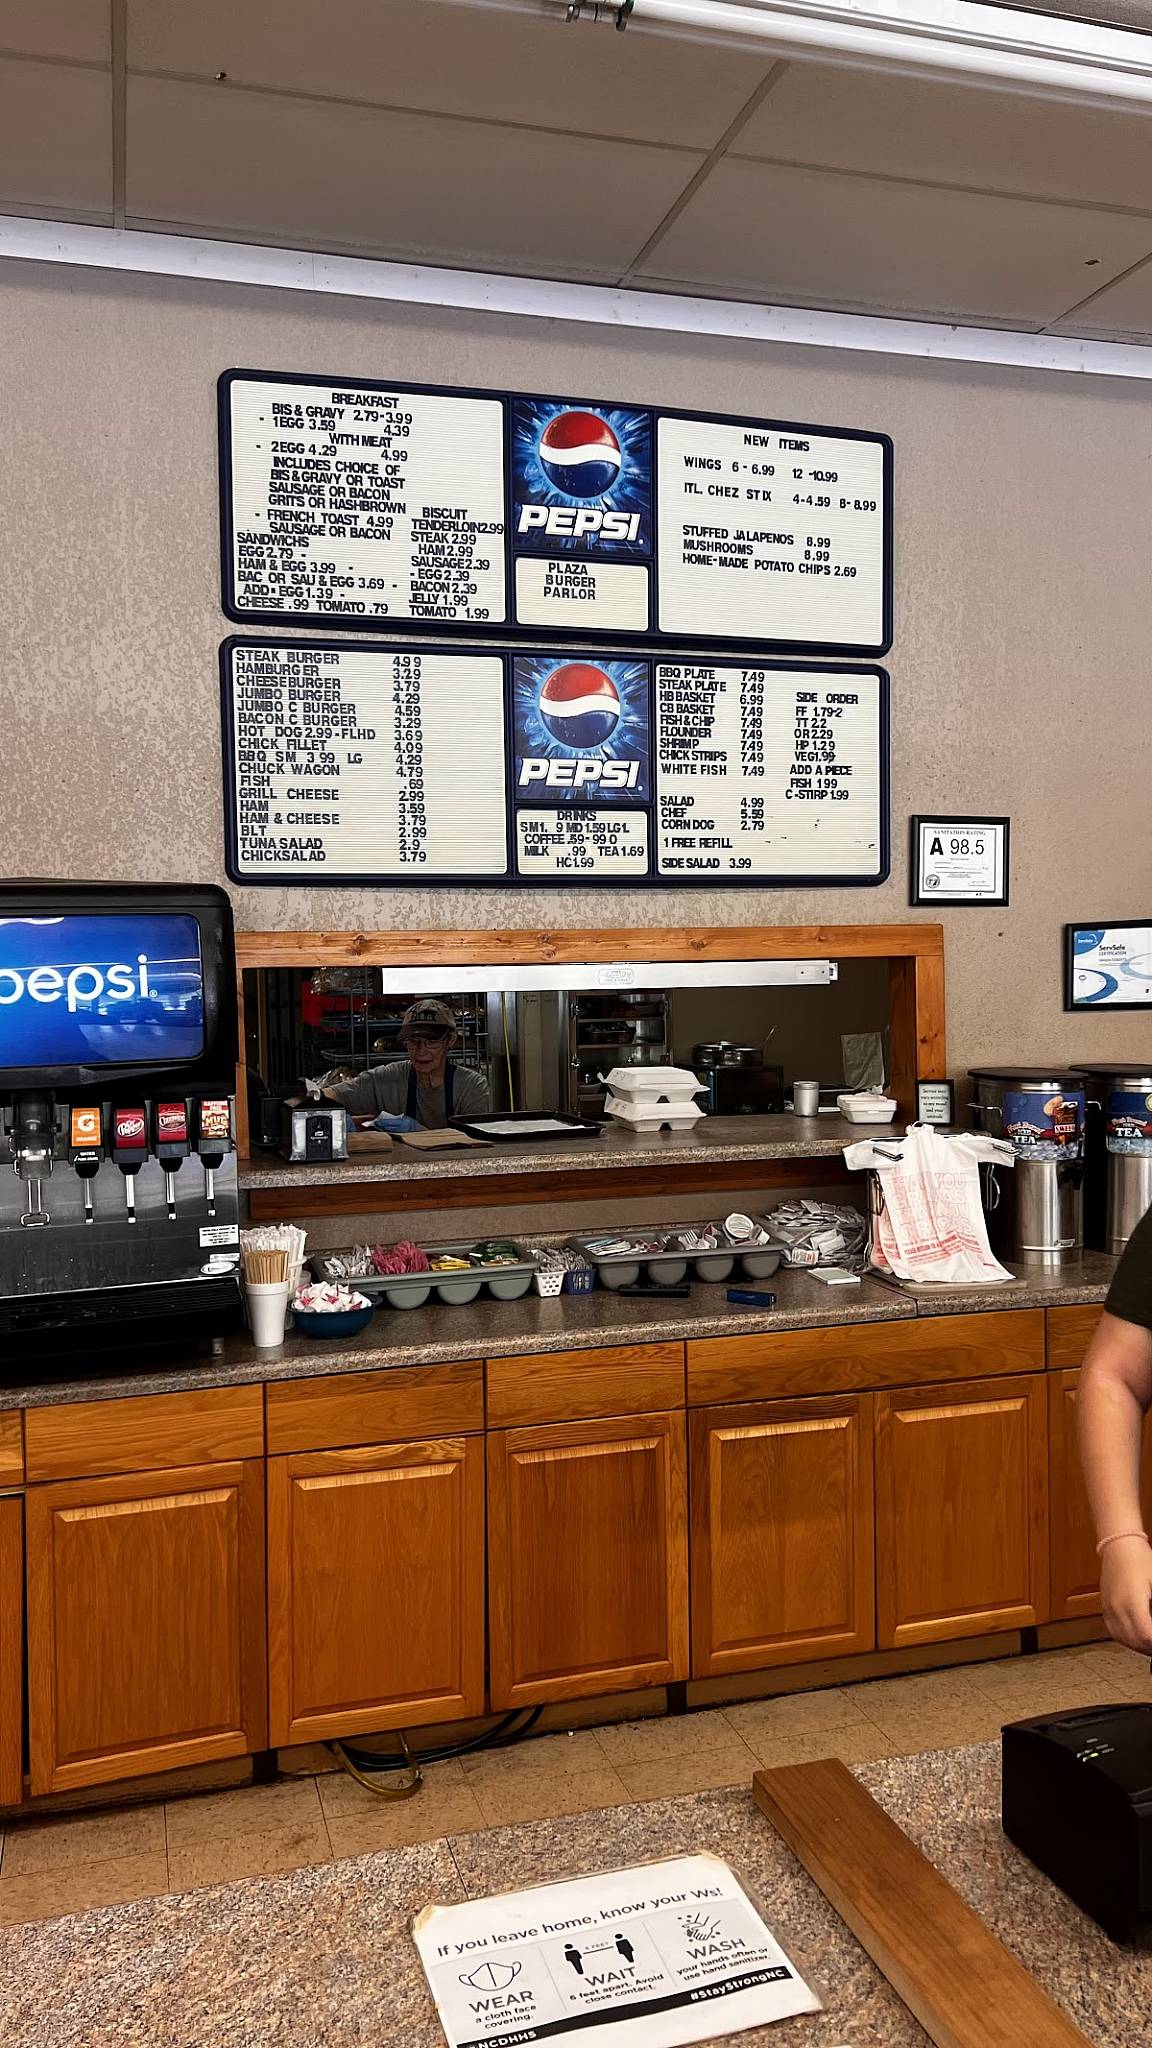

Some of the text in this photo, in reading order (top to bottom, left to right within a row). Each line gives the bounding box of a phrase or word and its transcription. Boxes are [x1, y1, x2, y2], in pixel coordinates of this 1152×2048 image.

[332, 393, 399, 408] BREAKFAST
[306, 406, 345, 419] GRAVY
[329, 433, 392, 448] WITH MEAT
[744, 434, 810, 451] NEW ITEMS
[273, 457, 379, 475] INCLUDES CHOICE
[684, 456, 803, 479] WINGS 6.99 12
[302, 470, 405, 489] GRAVY TOAST
[269, 482, 390, 500] SAUSAGE BACON
[684, 483, 739, 498] ITL. CHEZ
[268, 494, 406, 514] GRITS HASHBROWN
[267, 509, 359, 525] FRENCH TOAST
[422, 507, 468, 519] BISCUIT
[517, 504, 641, 541] PEPSI
[270, 522, 391, 540] SAUSAGE BACON
[411, 531, 450, 543] STEAK
[683, 525, 831, 548] STUFFED JALAPENOS 8.99
[237, 532, 309, 547] SANDWICHS
[684, 539, 830, 561] MUSHROOMS 8.99
[238, 558, 306, 572] HAM EGG
[549, 562, 588, 575] PLAZA
[683, 553, 856, 577] HOME-MADE POTATO CHIPS 2.69
[237, 571, 355, 587] BAC SAU EGG
[418, 569, 443, 579] EGG
[410, 580, 450, 592] BACON
[546, 574, 596, 588] BURGER
[409, 593, 439, 605] JELLY
[544, 586, 595, 600] PARLOR
[237, 595, 365, 613] CHEESE TOMATO
[410, 605, 457, 617] TOMATO
[236, 650, 340, 665] STEAK BURGER
[236, 662, 319, 676] HAMBURGER
[659, 667, 715, 679] BBQ PLATE
[236, 675, 341, 689] CHEESEBURGER
[659, 679, 726, 691] STEAK PLATE
[237, 688, 340, 701] JUMBO BURGER
[676, 692, 715, 703] BASKET
[796, 692, 858, 704] SIDE ORDER
[237, 701, 356, 714] JUMBO BURGER
[677, 704, 715, 715] BASKET
[237, 713, 357, 727] BACON BURGER
[660, 715, 715, 726] FISH CHIP
[238, 725, 302, 737] HOT DOG
[660, 726, 711, 738] FLOUNDER
[238, 738, 327, 751] CHICK FILLET
[660, 738, 699, 749] SHRIMP
[238, 751, 266, 761] BBQ
[660, 751, 727, 761] CHICK STRIPS
[238, 763, 340, 775] CHUCK WAGON
[518, 758, 640, 788] PEPSI
[661, 764, 727, 775] WHITE FISH
[790, 765, 852, 775] ADD PIECE
[241, 775, 270, 786] FISH
[238, 788, 339, 800] GRILL CHEESE
[240, 800, 269, 811] HAM
[660, 796, 694, 806] SALAD
[239, 813, 340, 825] HAM CHEESE
[557, 811, 596, 821] DRINKS
[661, 808, 687, 818] CHEF
[241, 825, 267, 836] BLT
[661, 819, 715, 830] CORN DOG
[671, 838, 733, 848] FREE REFILL
[930, 837, 984, 855] A 98.5
[524, 846, 619, 856] MILK TEA
[662, 858, 720, 868] SIDE SALAD
[206, 1115, 228, 1125] MUG
[1116, 1128, 1142, 1137] TEA
[1012, 1136, 1036, 1144] TEA
[437, 1887, 723, 1957] If you leave home, know your Ws!
[686, 1939, 746, 1960] WASH
[676, 1964, 699, 1975] your
[701, 1956, 730, 1968] hands
[731, 1950, 758, 1961] often
[584, 1967, 636, 1987] WAIT
[683, 1973, 700, 1981] use
[702, 1963, 727, 1976] hand
[579, 1990, 601, 1999] feet
[602, 1982, 633, 1995] apart.
[635, 1974, 664, 1986] Avoid
[691, 1969, 785, 2001] #StayStrongNC
[584, 1985, 656, 2004] close contact.
[468, 1990, 535, 2013] WEAR
[485, 2011, 512, 2021] cloth
[515, 2005, 536, 2014] face
